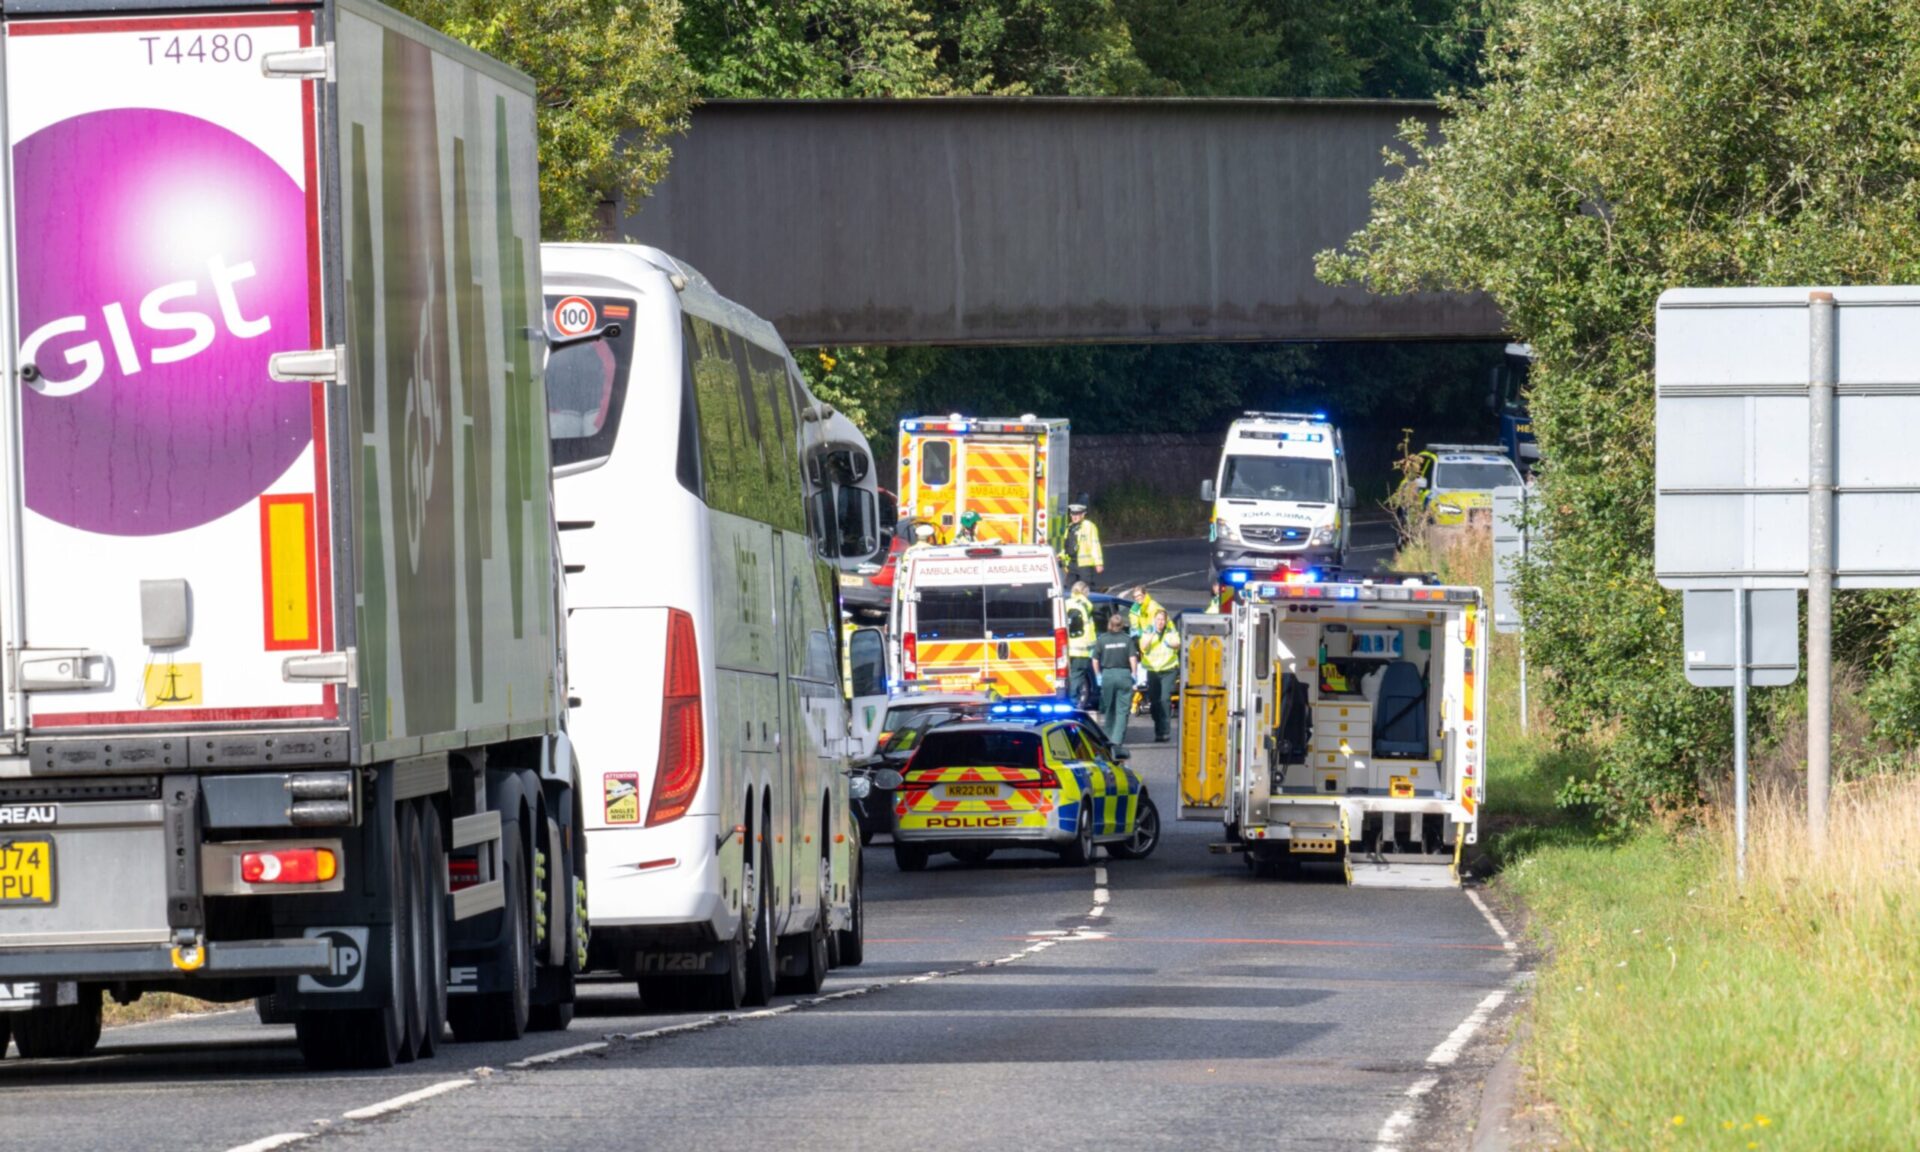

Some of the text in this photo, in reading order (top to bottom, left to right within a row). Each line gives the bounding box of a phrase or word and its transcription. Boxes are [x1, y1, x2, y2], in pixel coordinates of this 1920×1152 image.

[139, 34, 253, 65] T4480
[562, 308, 588, 326] 100
[919, 563, 1049, 576] AMBULANCE AMBAILEANS
[949, 785, 996, 796] KR22 CXN
[926, 816, 1017, 828] POLICE
